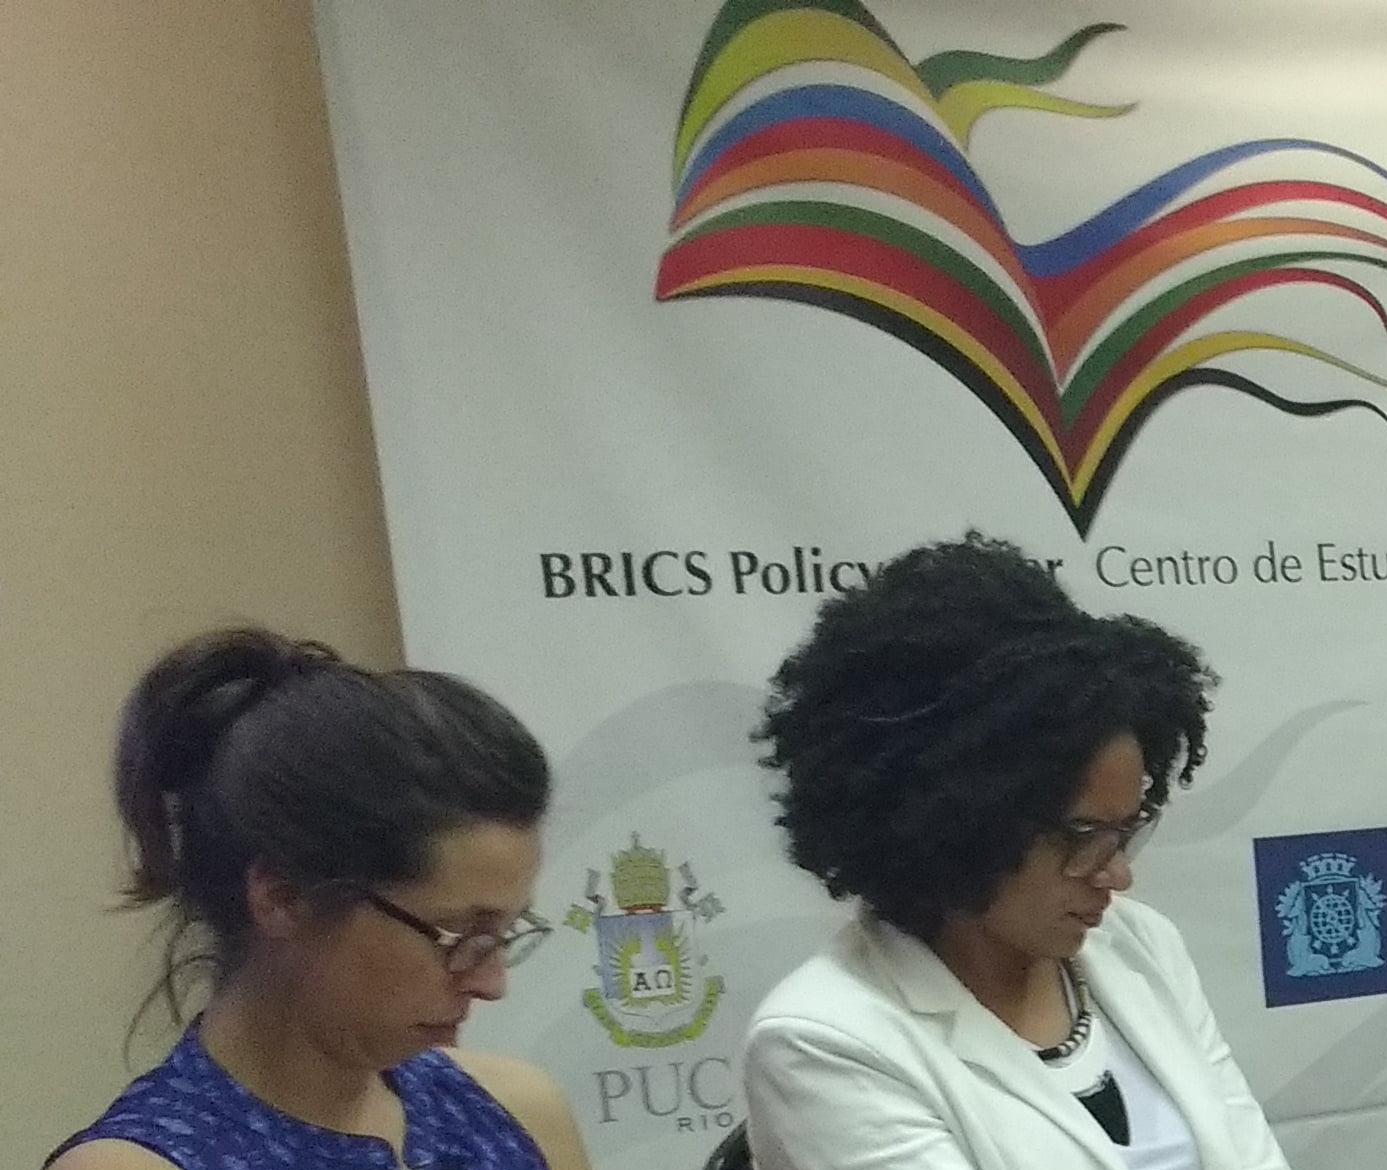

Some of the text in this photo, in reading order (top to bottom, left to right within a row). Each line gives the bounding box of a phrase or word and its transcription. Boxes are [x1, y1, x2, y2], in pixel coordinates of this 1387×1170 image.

[541, 550, 712, 598] BRICS
[1095, 545, 1239, 588] Centro
[1253, 541, 1302, 582] de
[593, 1057, 733, 1124] PUC
[677, 1112, 734, 1132] RIO
